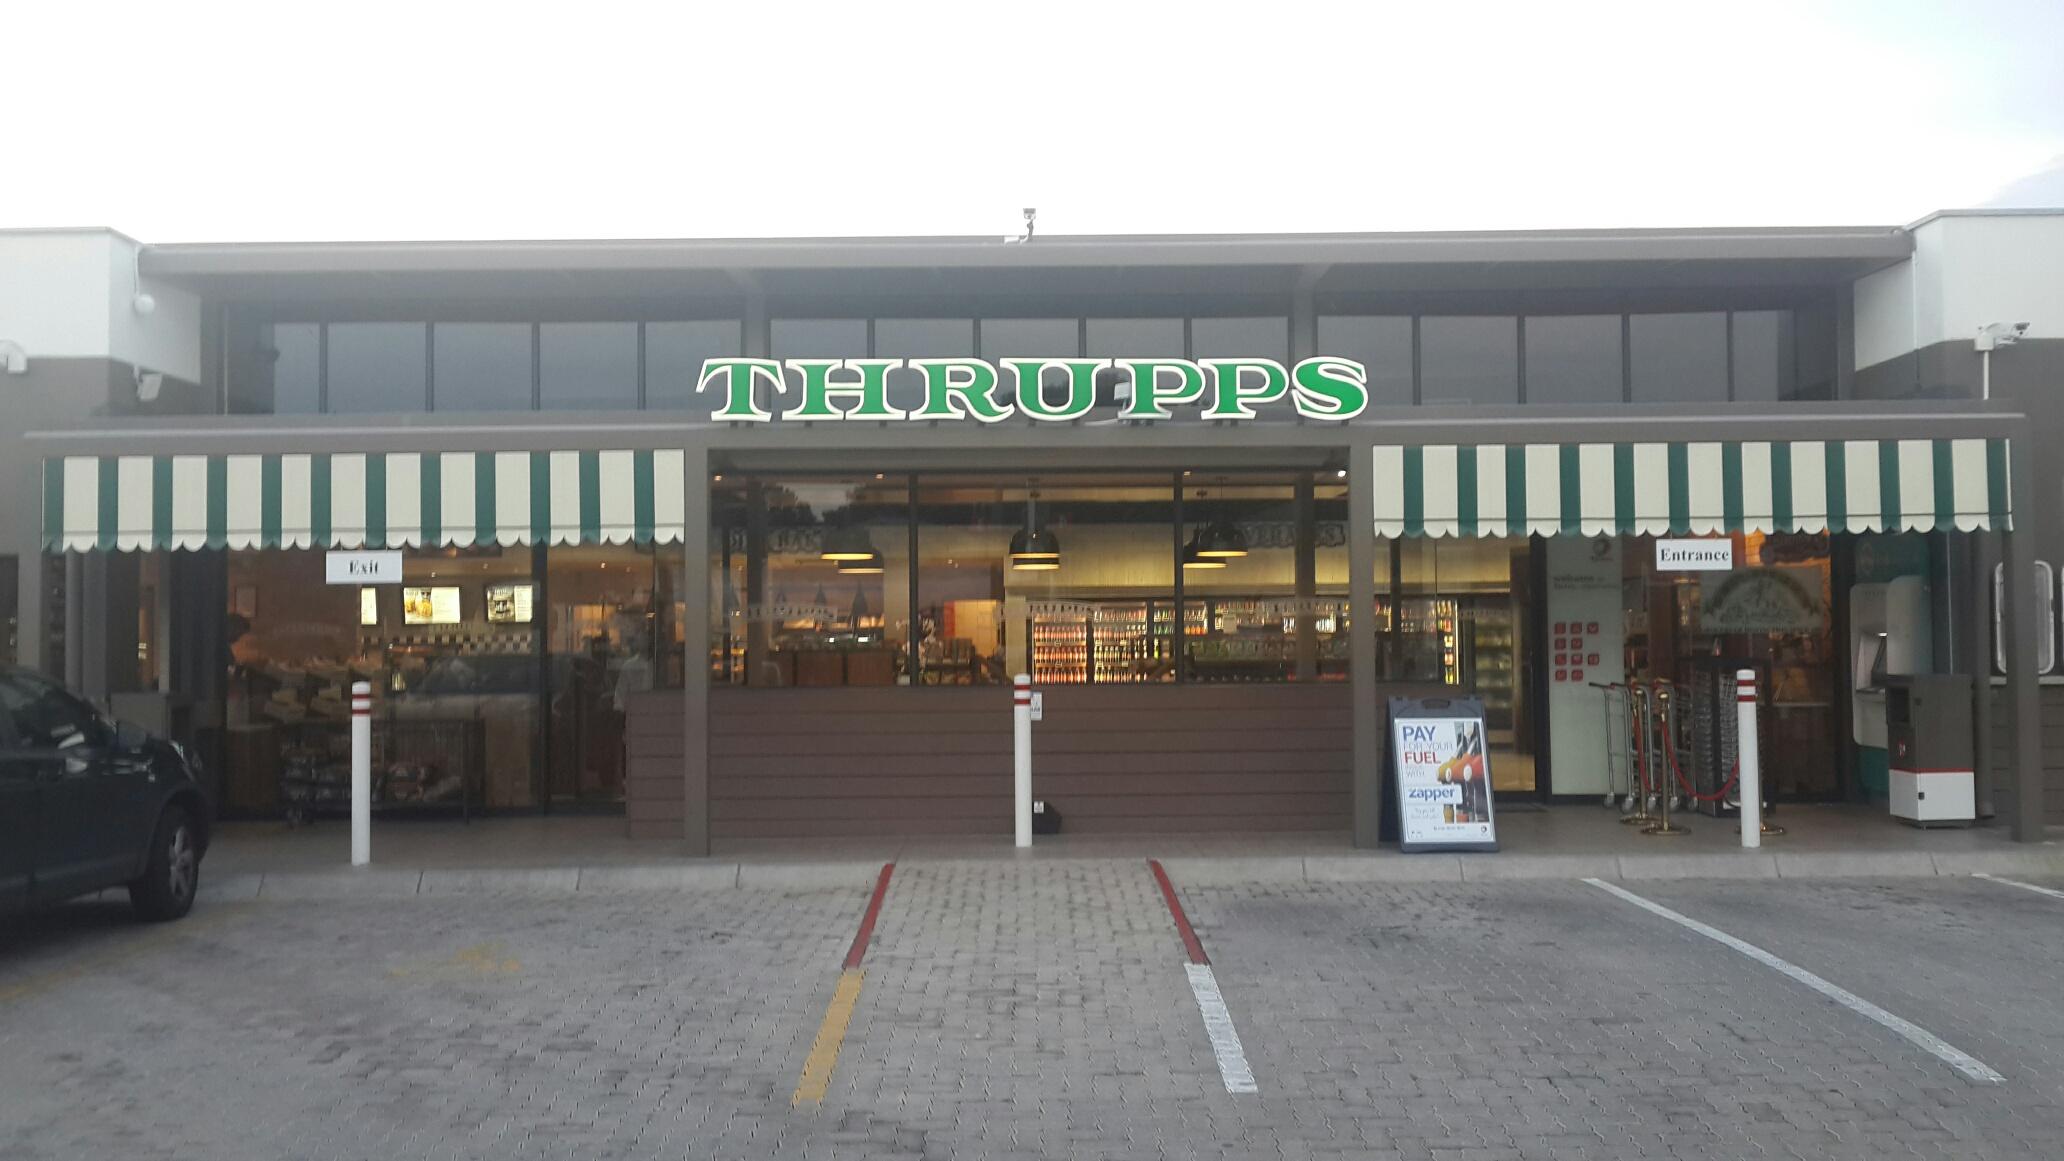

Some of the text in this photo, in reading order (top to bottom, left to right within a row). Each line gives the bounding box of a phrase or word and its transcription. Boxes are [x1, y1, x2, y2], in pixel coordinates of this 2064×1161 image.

[696, 356, 1369, 424] THRUPPS
[1661, 548, 1729, 561] Entrance
[349, 559, 379, 575] Exit
[1402, 725, 1436, 742] PAY
[1426, 742, 1453, 751] YOUR
[1404, 751, 1441, 764] FUEL
[1408, 787, 1455, 801] zapper
